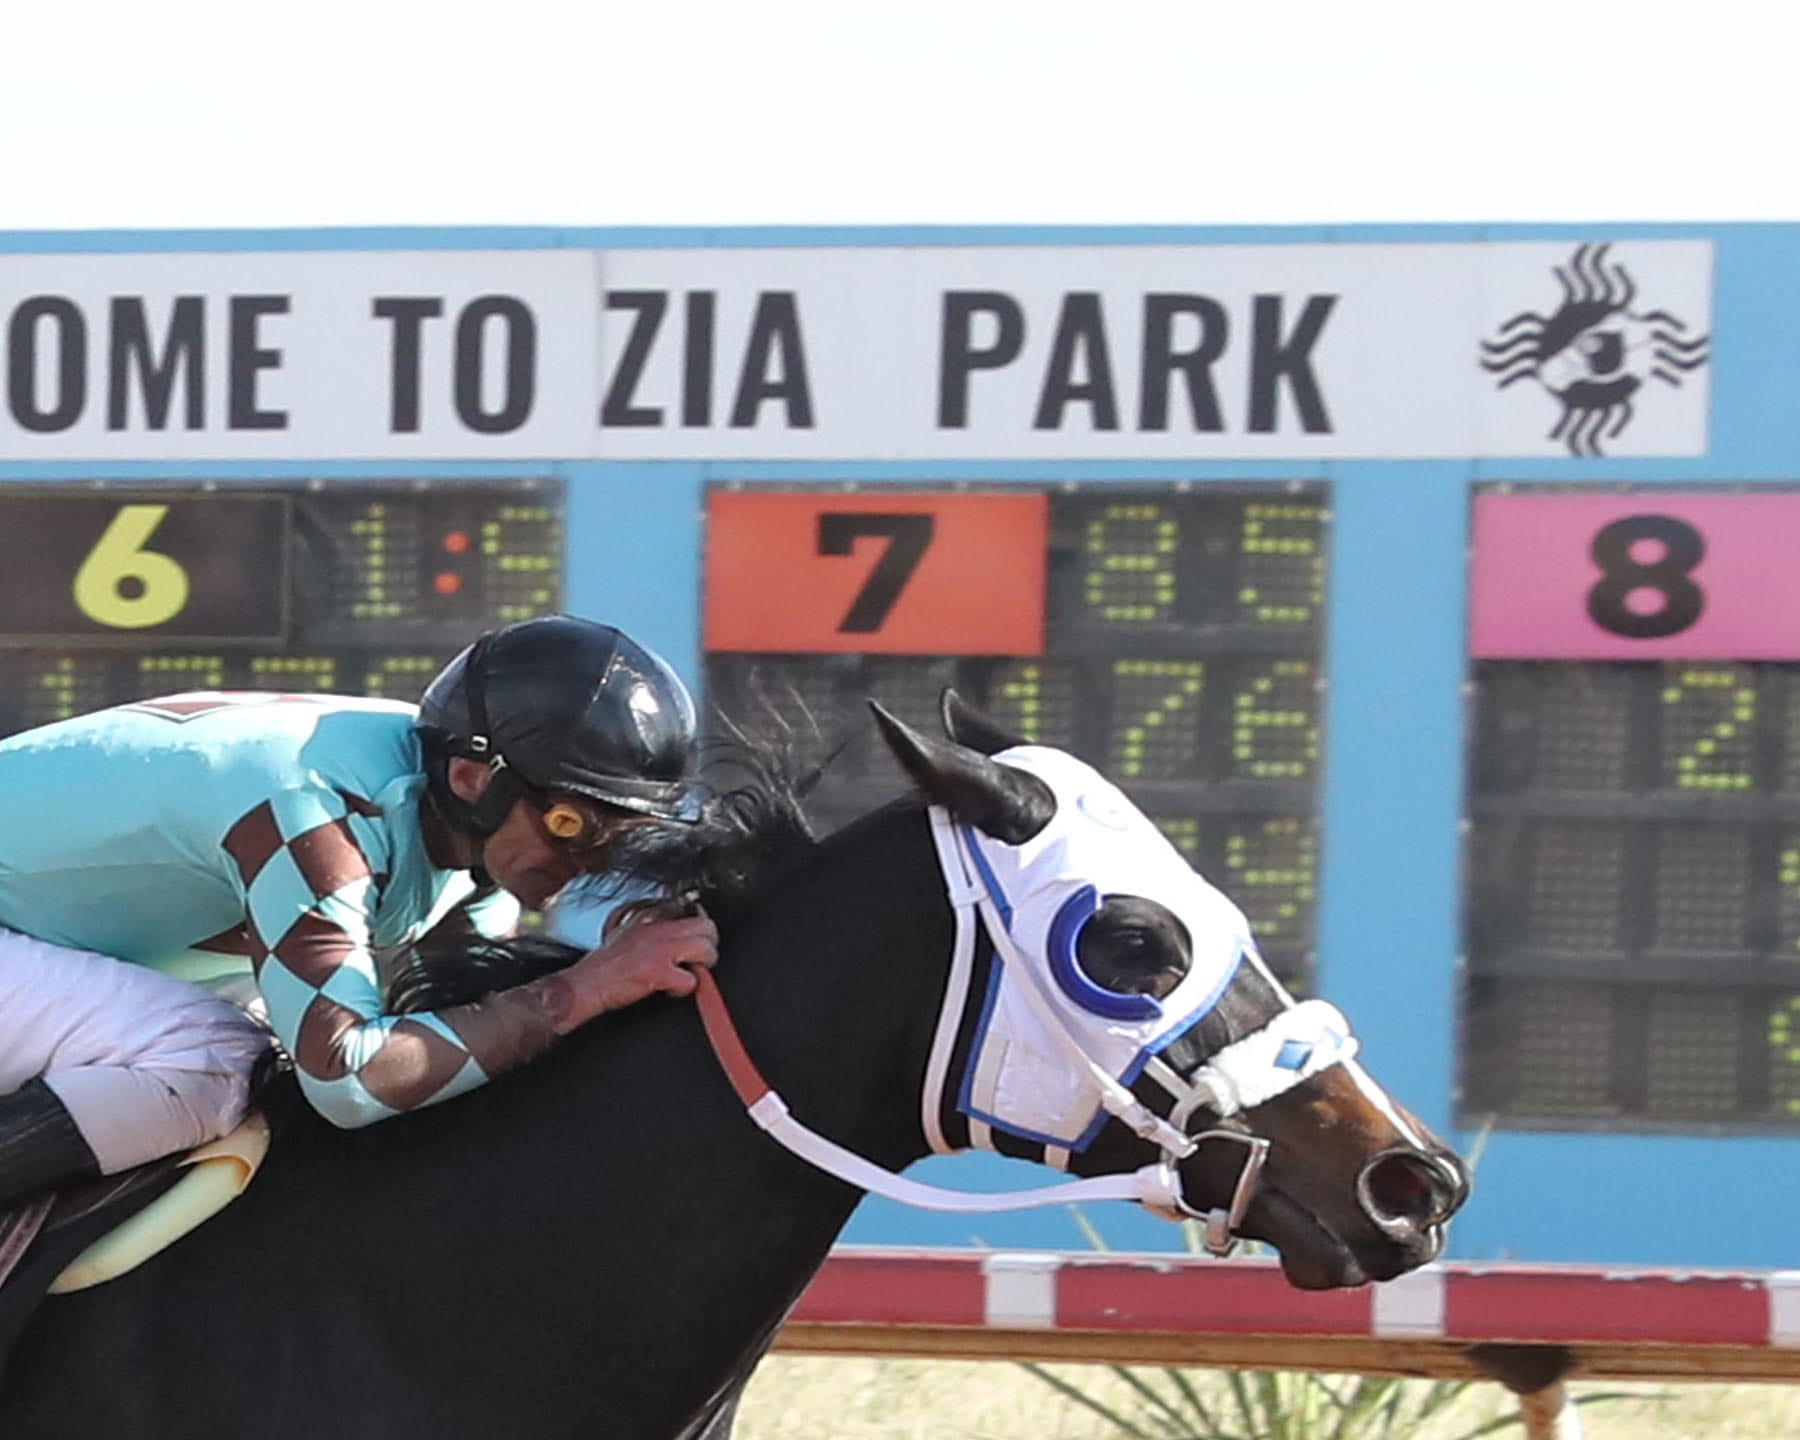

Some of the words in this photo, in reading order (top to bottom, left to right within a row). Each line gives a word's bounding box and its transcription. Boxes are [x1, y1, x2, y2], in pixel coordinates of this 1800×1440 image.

[373, 295, 537, 435] TO
[601, 290, 817, 429] ZIA
[936, 291, 1340, 434] PARK
[73, 505, 189, 628] 6
[816, 512, 936, 634] 7
[1585, 513, 1708, 640] 8
